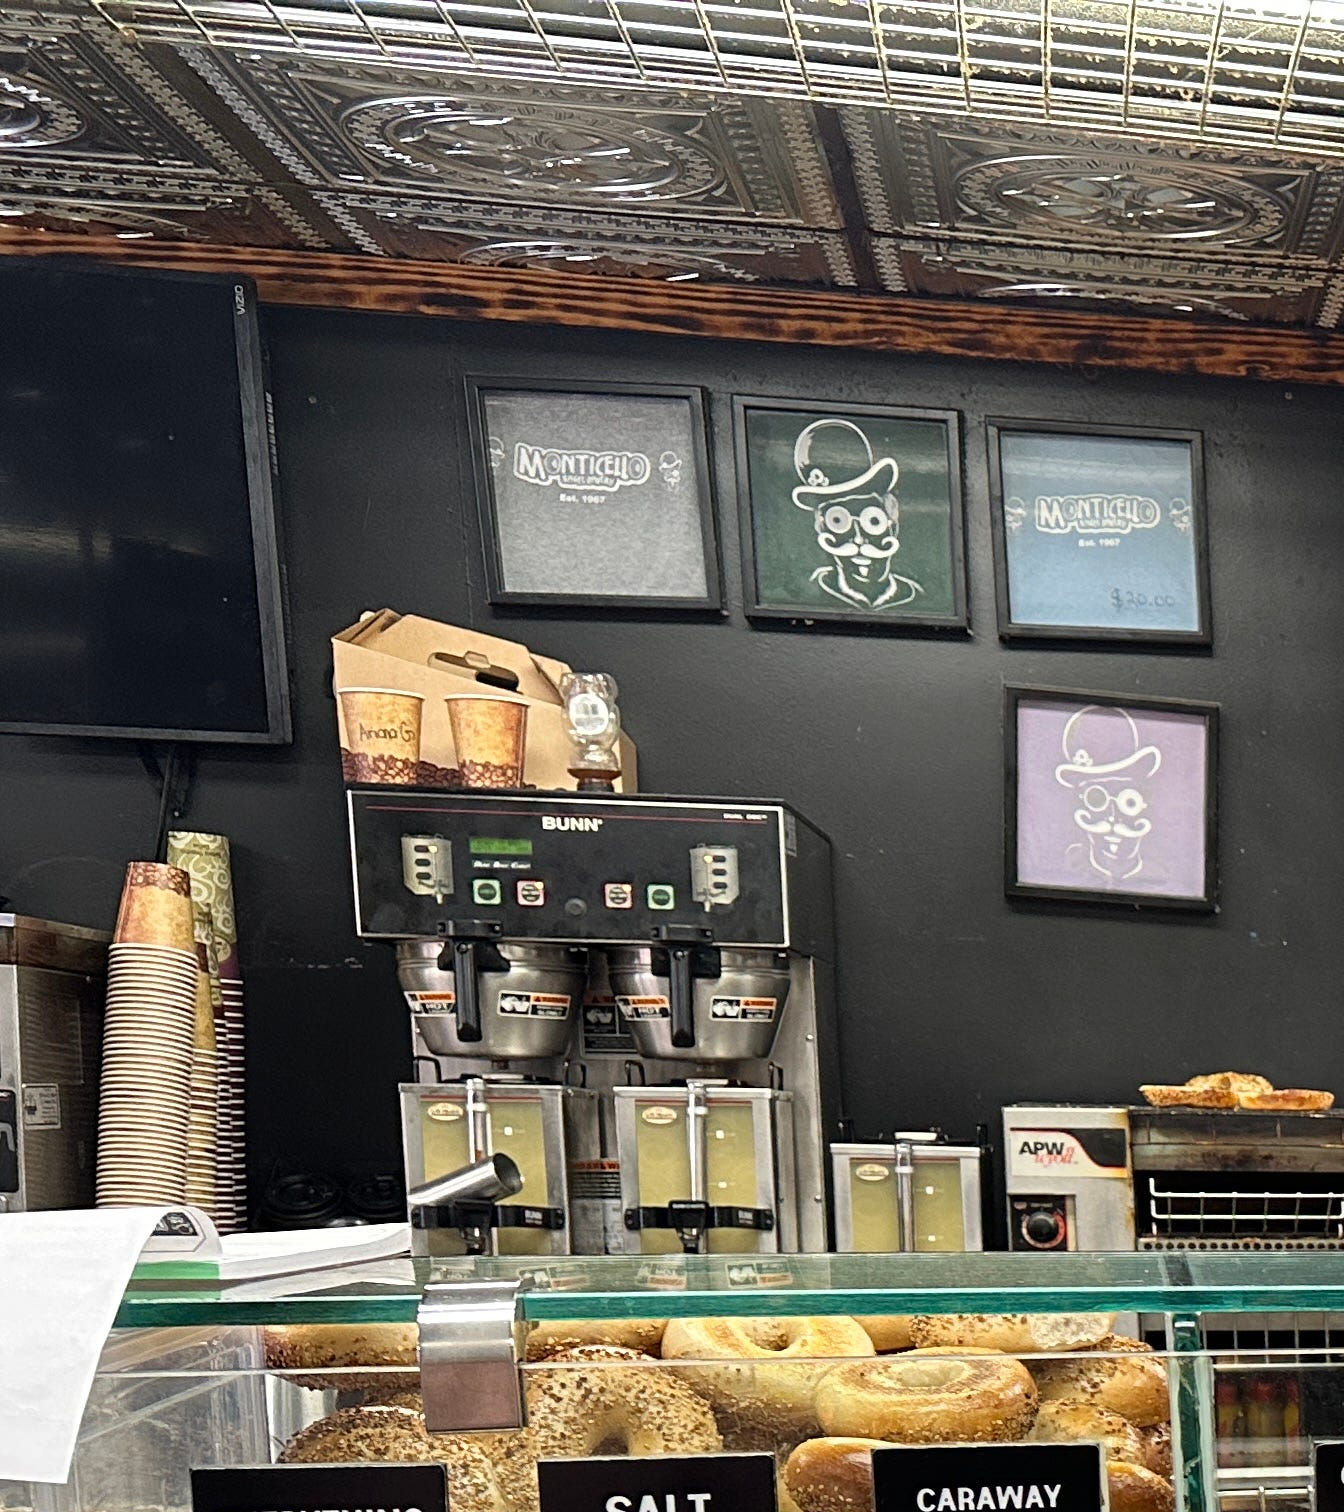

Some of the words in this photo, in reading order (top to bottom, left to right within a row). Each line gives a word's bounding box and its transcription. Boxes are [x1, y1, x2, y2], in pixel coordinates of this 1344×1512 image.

[542, 816, 600, 832] BUNN
[1019, 1141, 1064, 1155] APW
[917, 1485, 1061, 1512] CARAWAY
